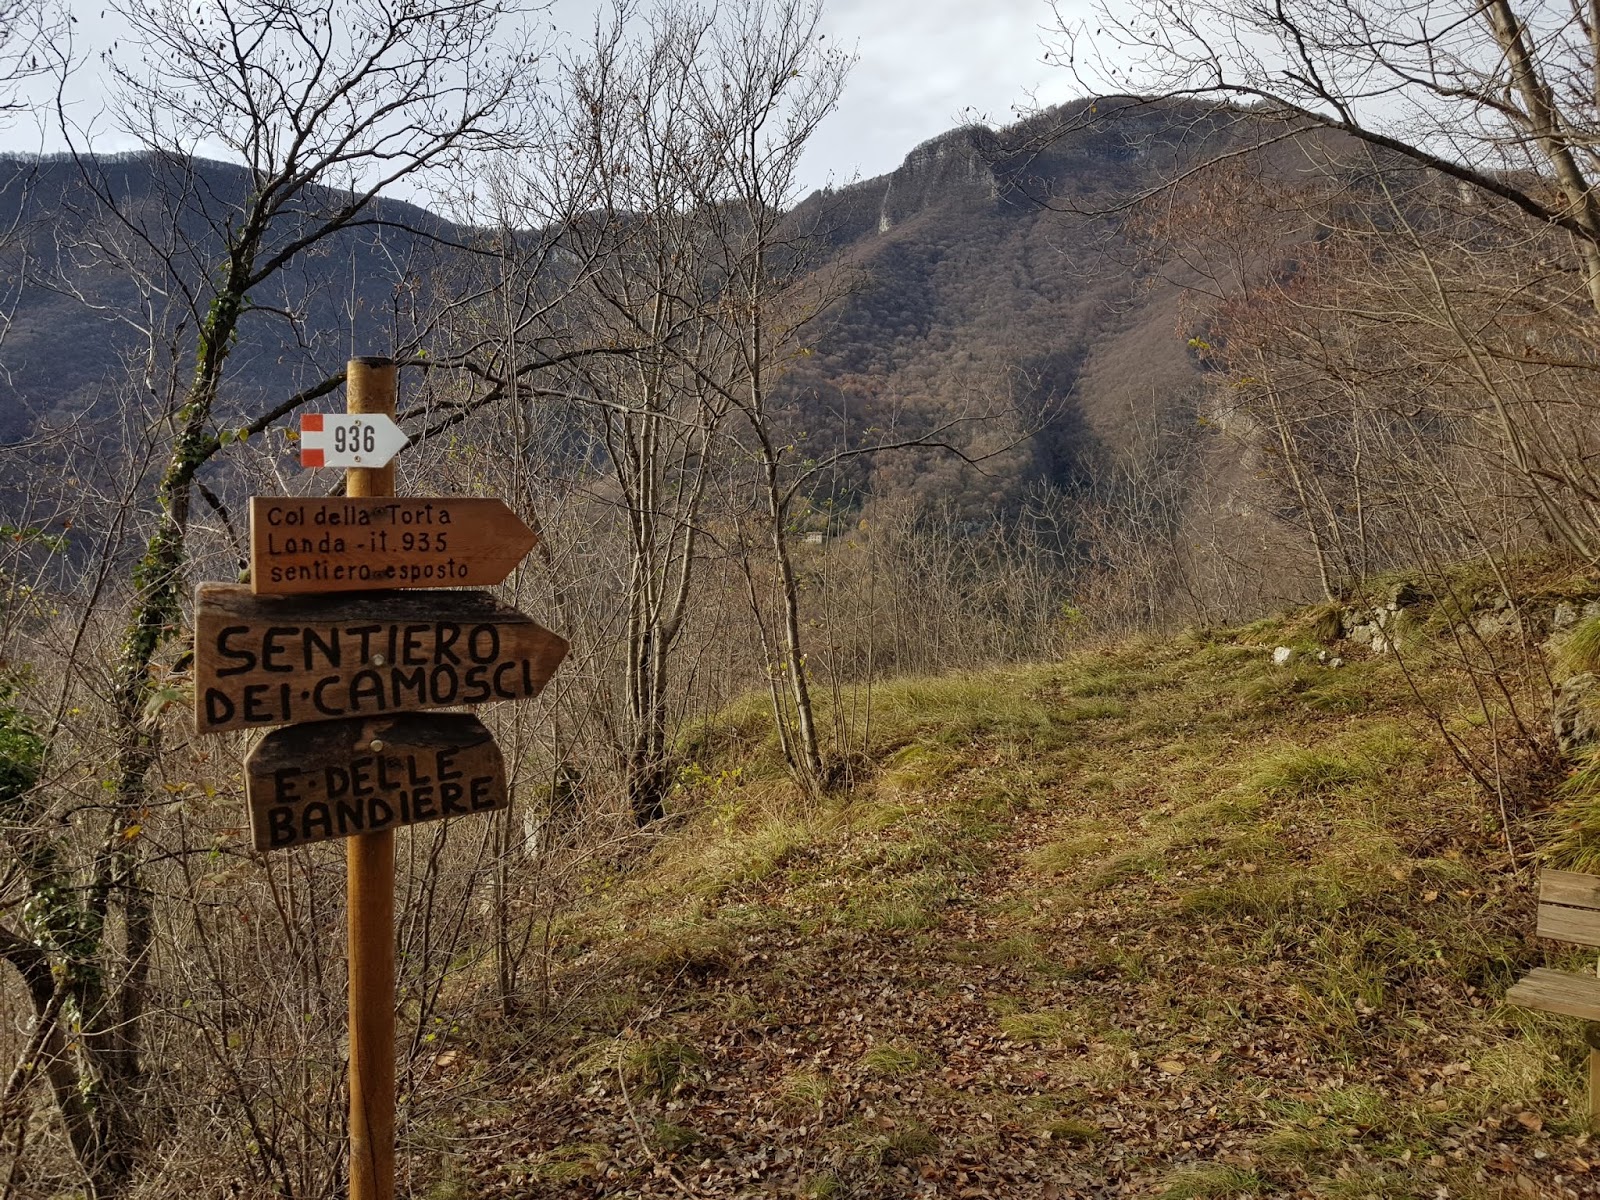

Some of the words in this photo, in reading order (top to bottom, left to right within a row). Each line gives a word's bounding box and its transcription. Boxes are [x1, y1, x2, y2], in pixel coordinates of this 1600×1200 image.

[335, 425, 375, 453] 936
[267, 506, 304, 526] Col
[314, 505, 371, 526] della
[385, 504, 451, 525] Torta
[268, 532, 345, 556] Londa
[270, 559, 370, 582] sentiero
[384, 558, 468, 583] esposto
[216, 621, 501, 678] SENTIERO
[268, 776, 496, 847] BANDIERE
